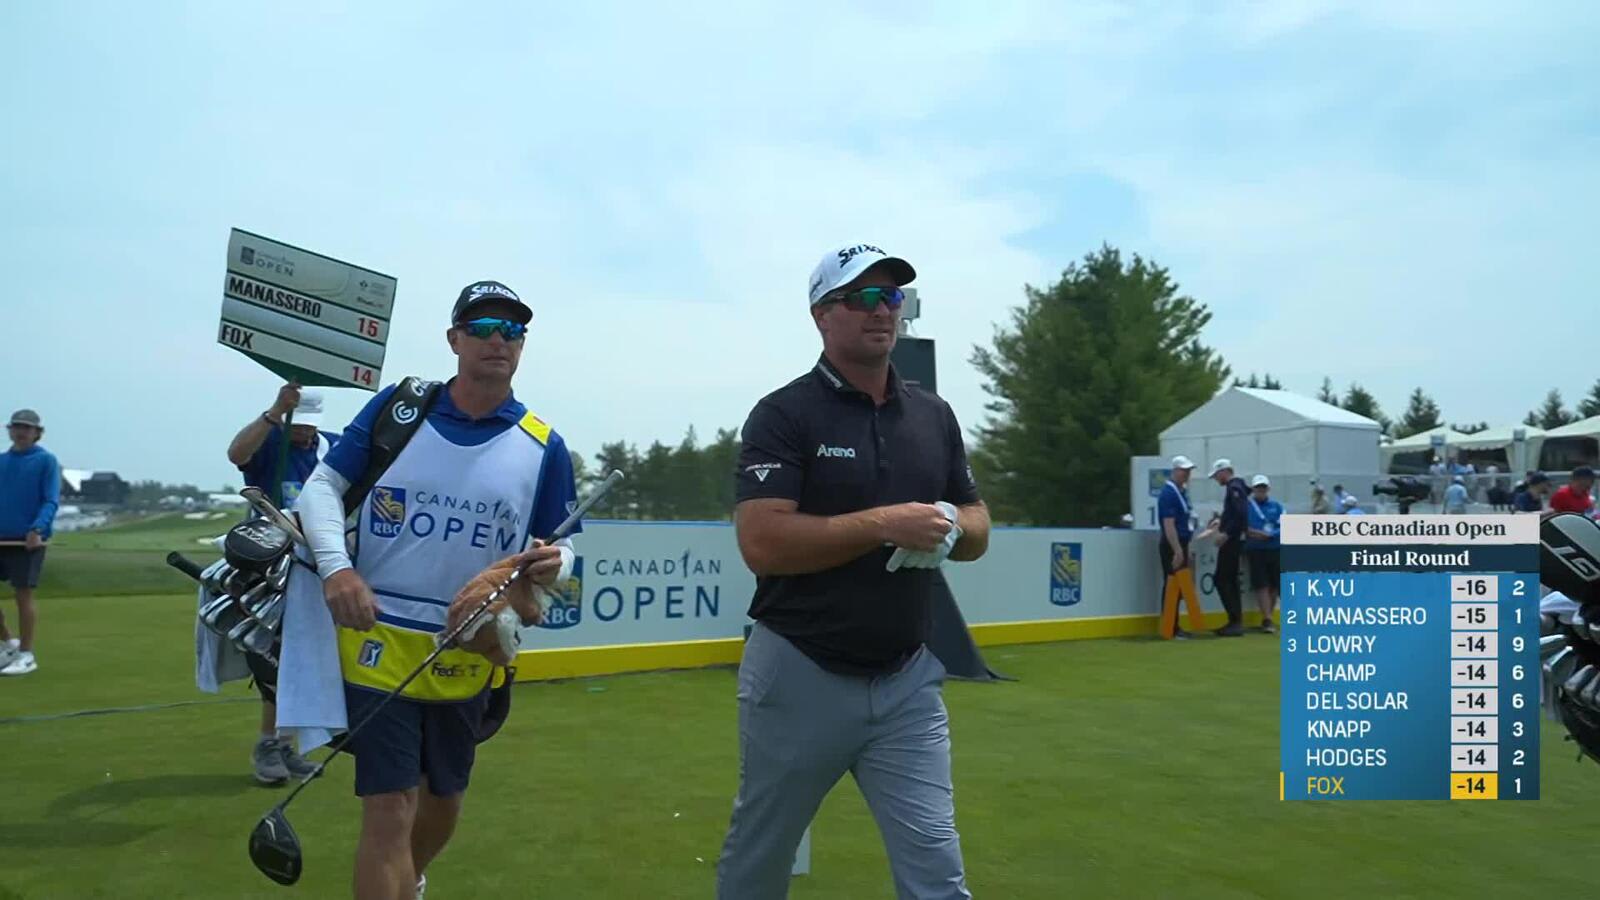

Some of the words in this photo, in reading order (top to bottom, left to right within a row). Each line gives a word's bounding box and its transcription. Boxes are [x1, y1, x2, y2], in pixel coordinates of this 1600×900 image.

[255, 258, 294, 277] OPEN
[229, 276, 322, 319] MANASSERO
[221, 324, 254, 350] FOX
[357, 317, 380, 338] 15
[352, 365, 373, 386] 14
[816, 443, 856, 458] Arena
[410, 512, 516, 552] OPEN
[595, 549, 721, 578] CANADIAN
[593, 585, 720, 622] OPEN
[1052, 587, 1080, 602] RBC
